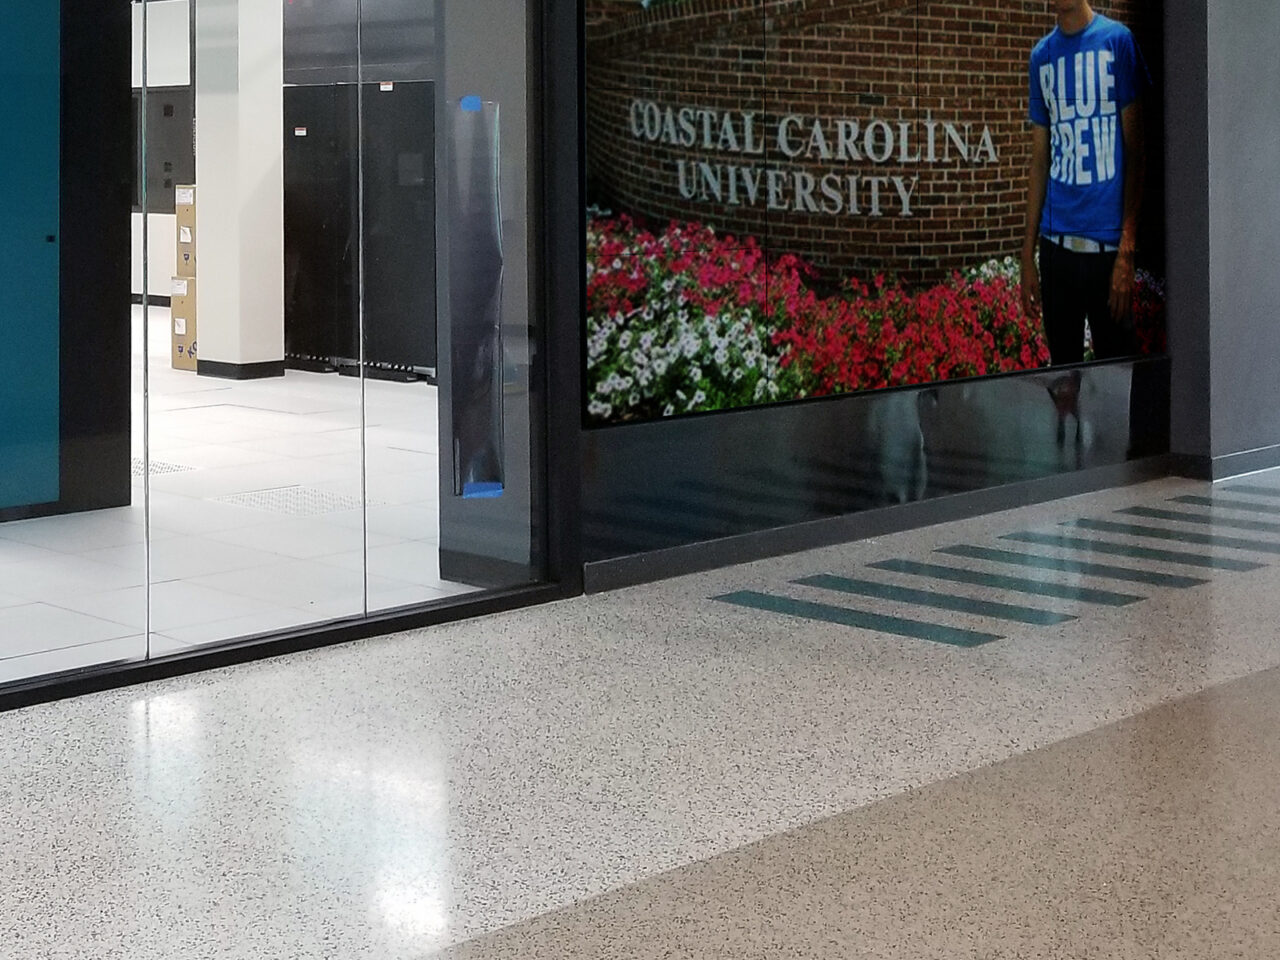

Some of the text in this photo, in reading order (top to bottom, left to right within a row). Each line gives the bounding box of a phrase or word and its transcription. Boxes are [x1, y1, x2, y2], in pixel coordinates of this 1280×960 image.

[1039, 50, 1116, 125] BLUE
[630, 98, 999, 163] COASTAL CAROLINA
[1050, 115, 1117, 185] CREW
[678, 159, 919, 216] UNIVERSITY
